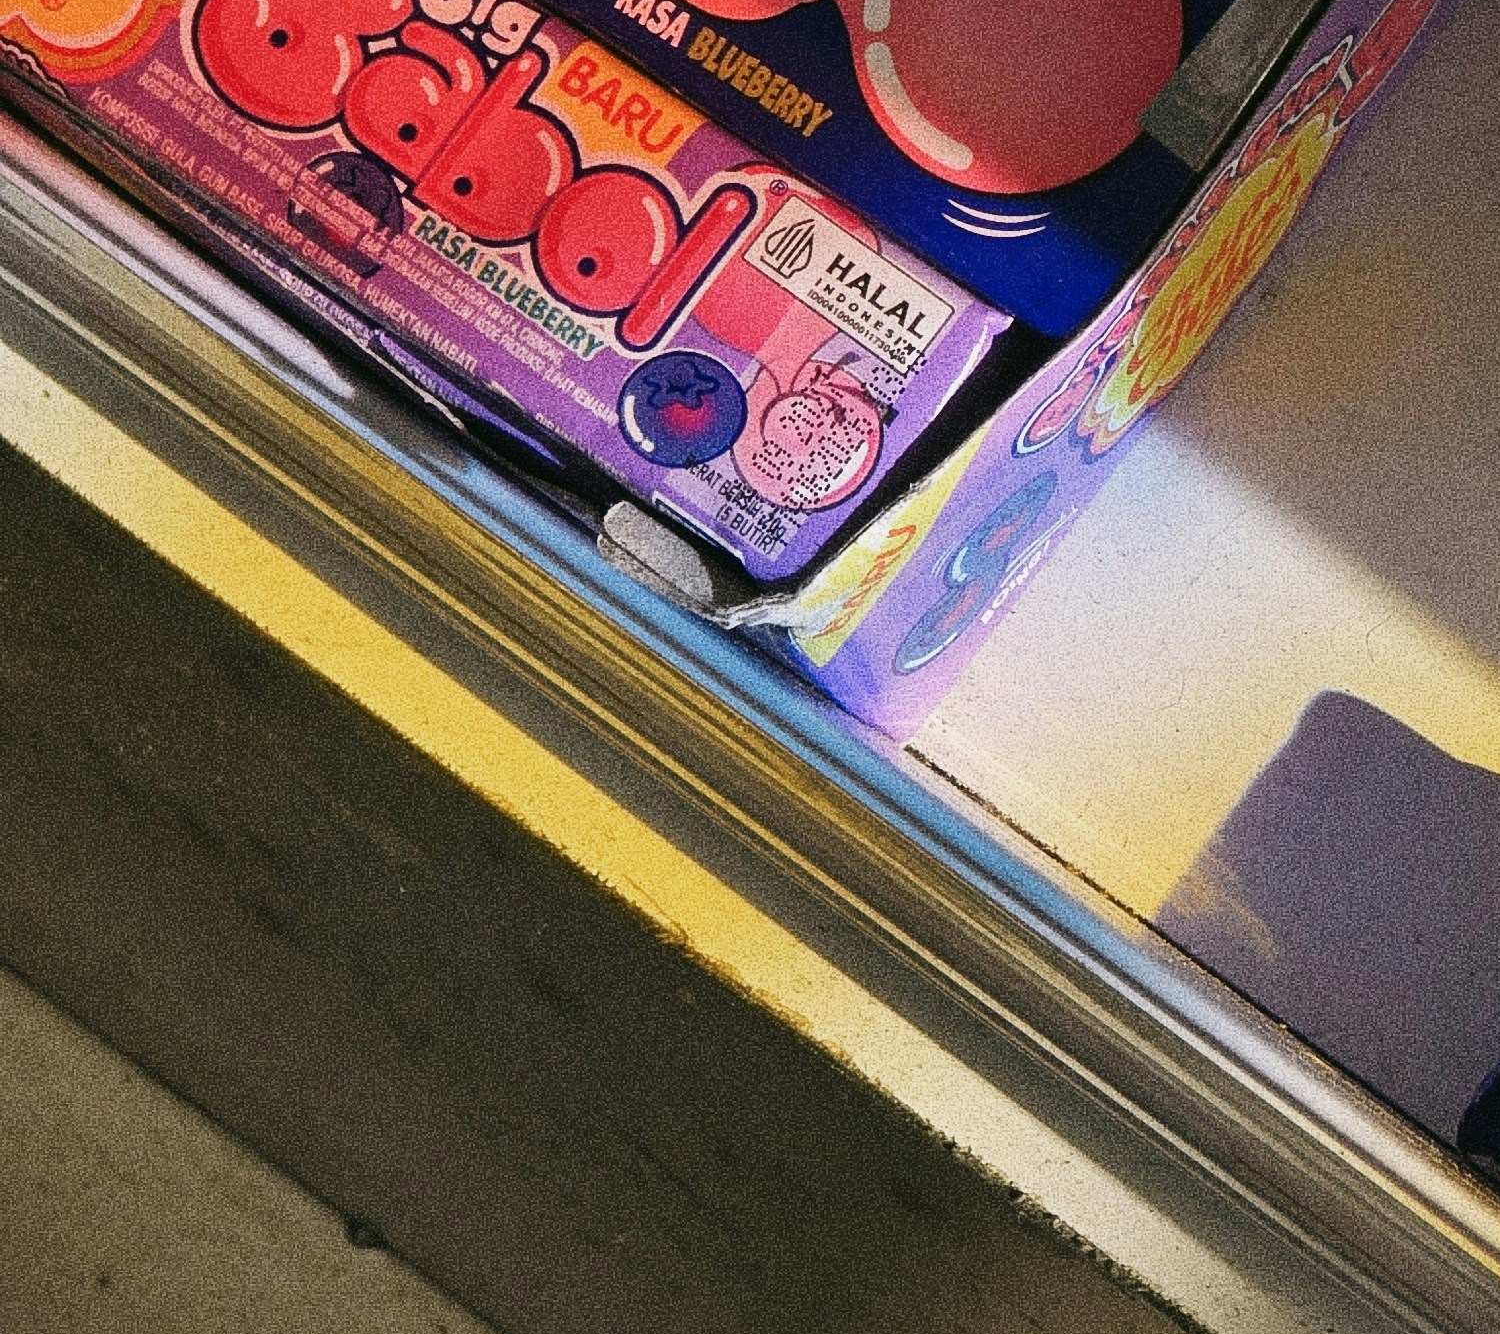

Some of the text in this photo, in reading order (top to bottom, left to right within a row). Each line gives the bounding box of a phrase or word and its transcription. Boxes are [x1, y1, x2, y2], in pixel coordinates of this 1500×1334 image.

[559, 56, 682, 154] BARU
[688, 27, 832, 135] BLUEBERRY
[413, 215, 606, 360] RASA BLUEBERRY
[824, 253, 934, 337] HALAL
[681, 454, 720, 487] BERAT
[729, 513, 778, 553] BUTIR)
